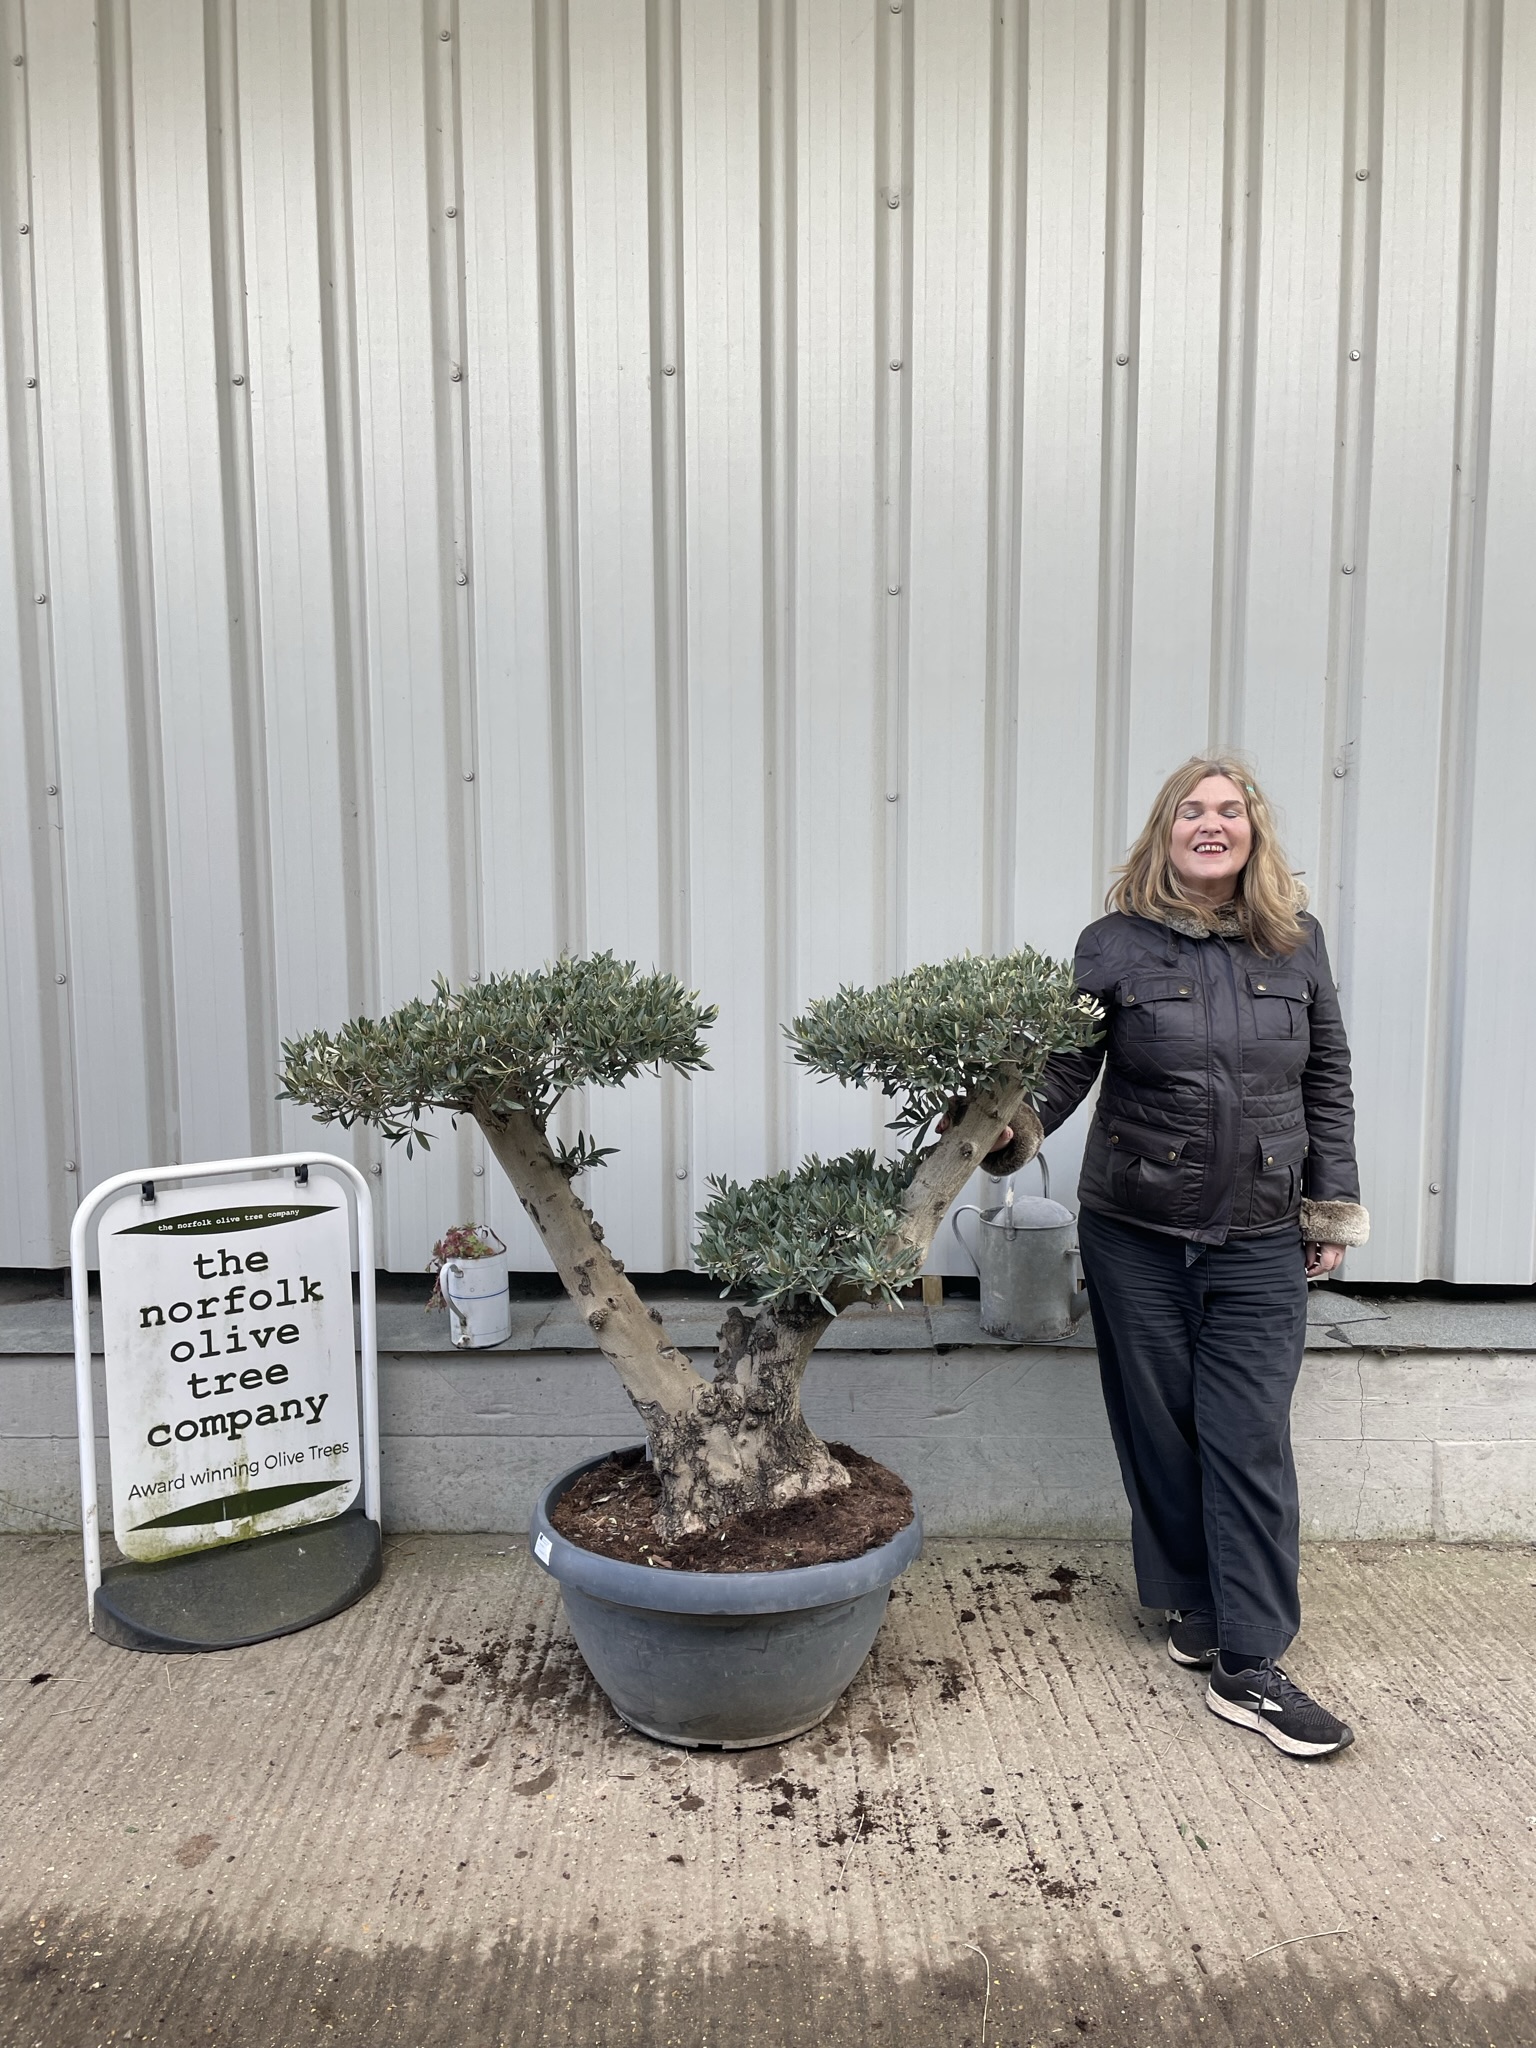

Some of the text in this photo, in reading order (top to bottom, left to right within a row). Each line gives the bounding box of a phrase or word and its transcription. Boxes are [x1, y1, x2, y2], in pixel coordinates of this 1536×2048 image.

[158, 1209, 300, 1232] the norfolk olive tree company
[193, 1248, 269, 1280] the
[139, 1275, 324, 1328] norfolk
[170, 1323, 300, 1363] olive
[187, 1363, 289, 1399] tree
[147, 1393, 329, 1447] company
[128, 1442, 350, 1501] Award winning Olive Trees
